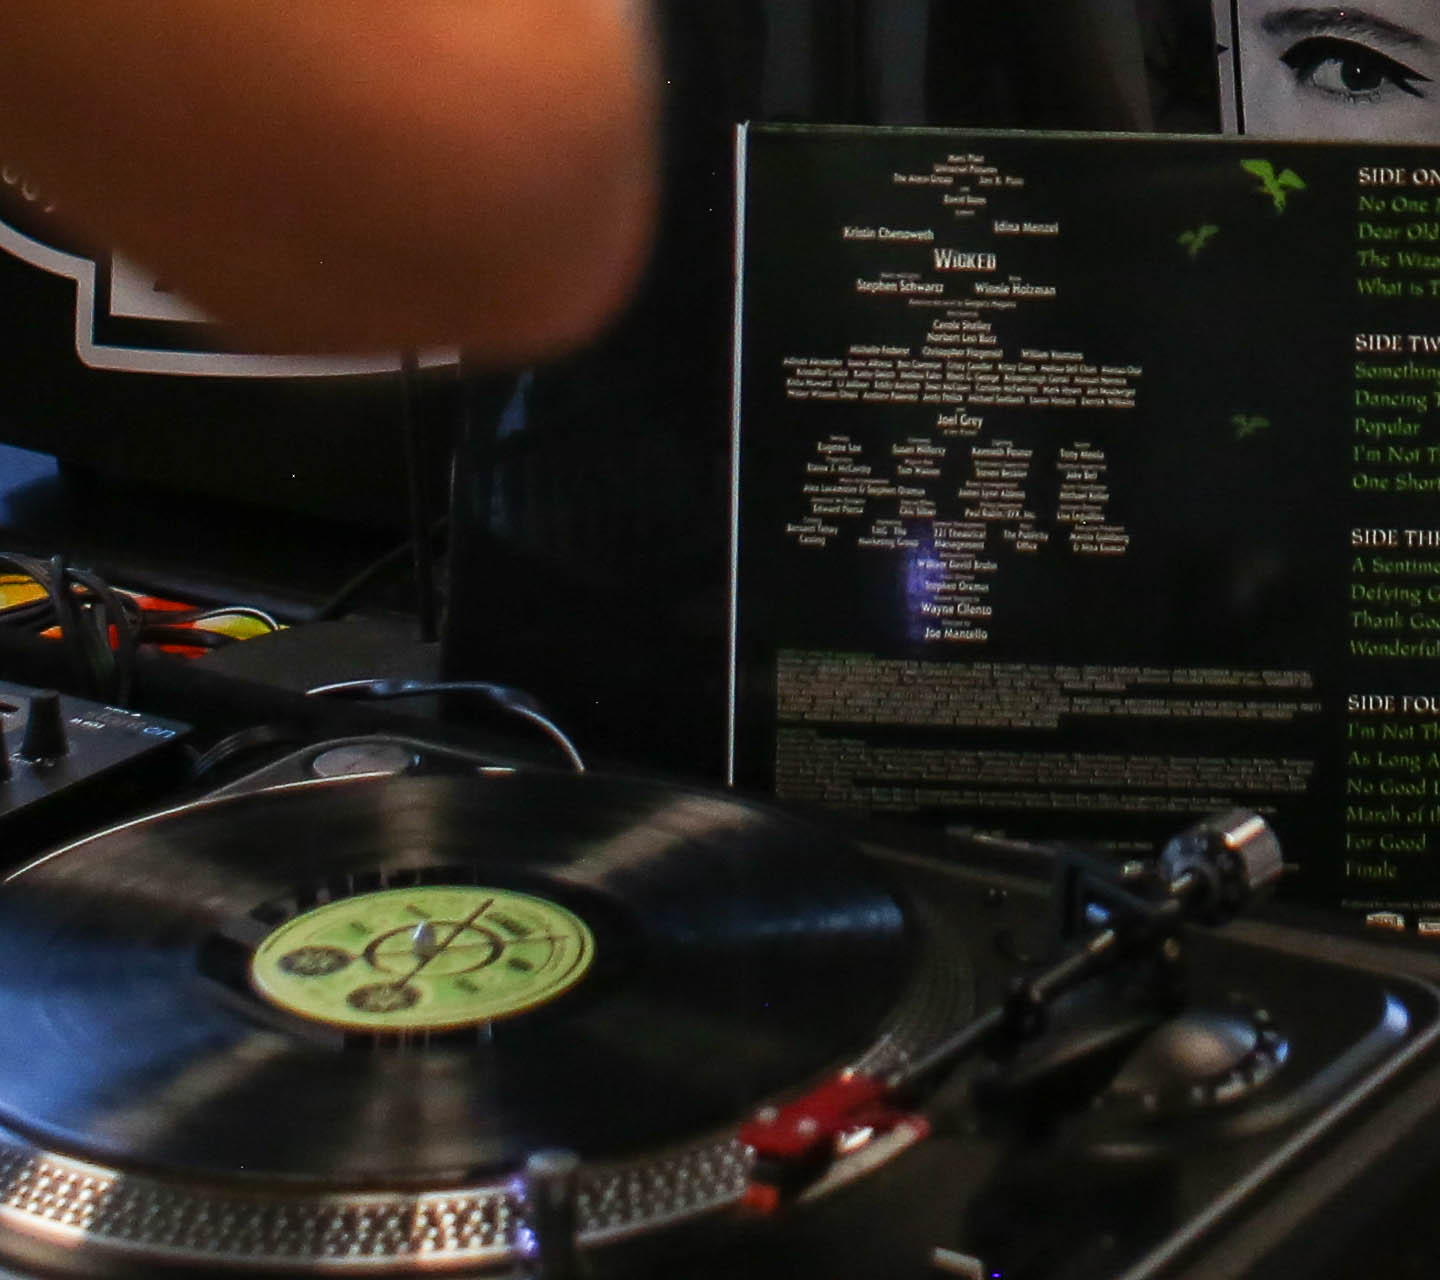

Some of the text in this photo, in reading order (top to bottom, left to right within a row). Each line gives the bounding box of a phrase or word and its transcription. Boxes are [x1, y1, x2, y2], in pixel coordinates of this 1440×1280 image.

[1359, 167, 1405, 184] SIDE
[1359, 195, 1386, 212] No
[1391, 196, 1428, 213] One
[844, 227, 876, 238] Kristin
[1023, 223, 1059, 233] Menzel
[1358, 222, 1400, 240] Dear
[1406, 222, 1440, 241] Old
[935, 249, 997, 269] WICKED
[1357, 249, 1391, 268] The
[857, 279, 944, 292] Stephen Schwartz
[975, 283, 1057, 295] Winnie Holzman
[1357, 277, 1402, 296] What
[1355, 333, 1402, 351] SIDE
[1354, 389, 1428, 413] Dancing
[938, 414, 984, 428] Joel Grey
[1355, 416, 1421, 438] Popular
[1353, 445, 1382, 462] I'm
[1388, 446, 1420, 463] Not
[1352, 474, 1389, 489] One
[1351, 528, 1397, 545] SIDE
[1352, 556, 1364, 573] A
[1351, 583, 1422, 607] Defying
[920, 602, 955, 616] Wayne
[1352, 609, 1403, 628] Thank
[925, 627, 988, 640] Joe Mantello
[1350, 639, 1440, 657] Wonderful
[1348, 695, 1394, 711] SIDE
[1348, 722, 1376, 737] I'm
[1382, 724, 1414, 740] Not
[1348, 751, 1371, 766] As
[1377, 751, 1422, 774] Long
[1347, 778, 1374, 794] No
[1379, 778, 1427, 796] Good
[1346, 805, 1401, 822] March
[1406, 809, 1423, 823] of
[1346, 833, 1427, 851] For Good
[1345, 860, 1396, 878] Finale
